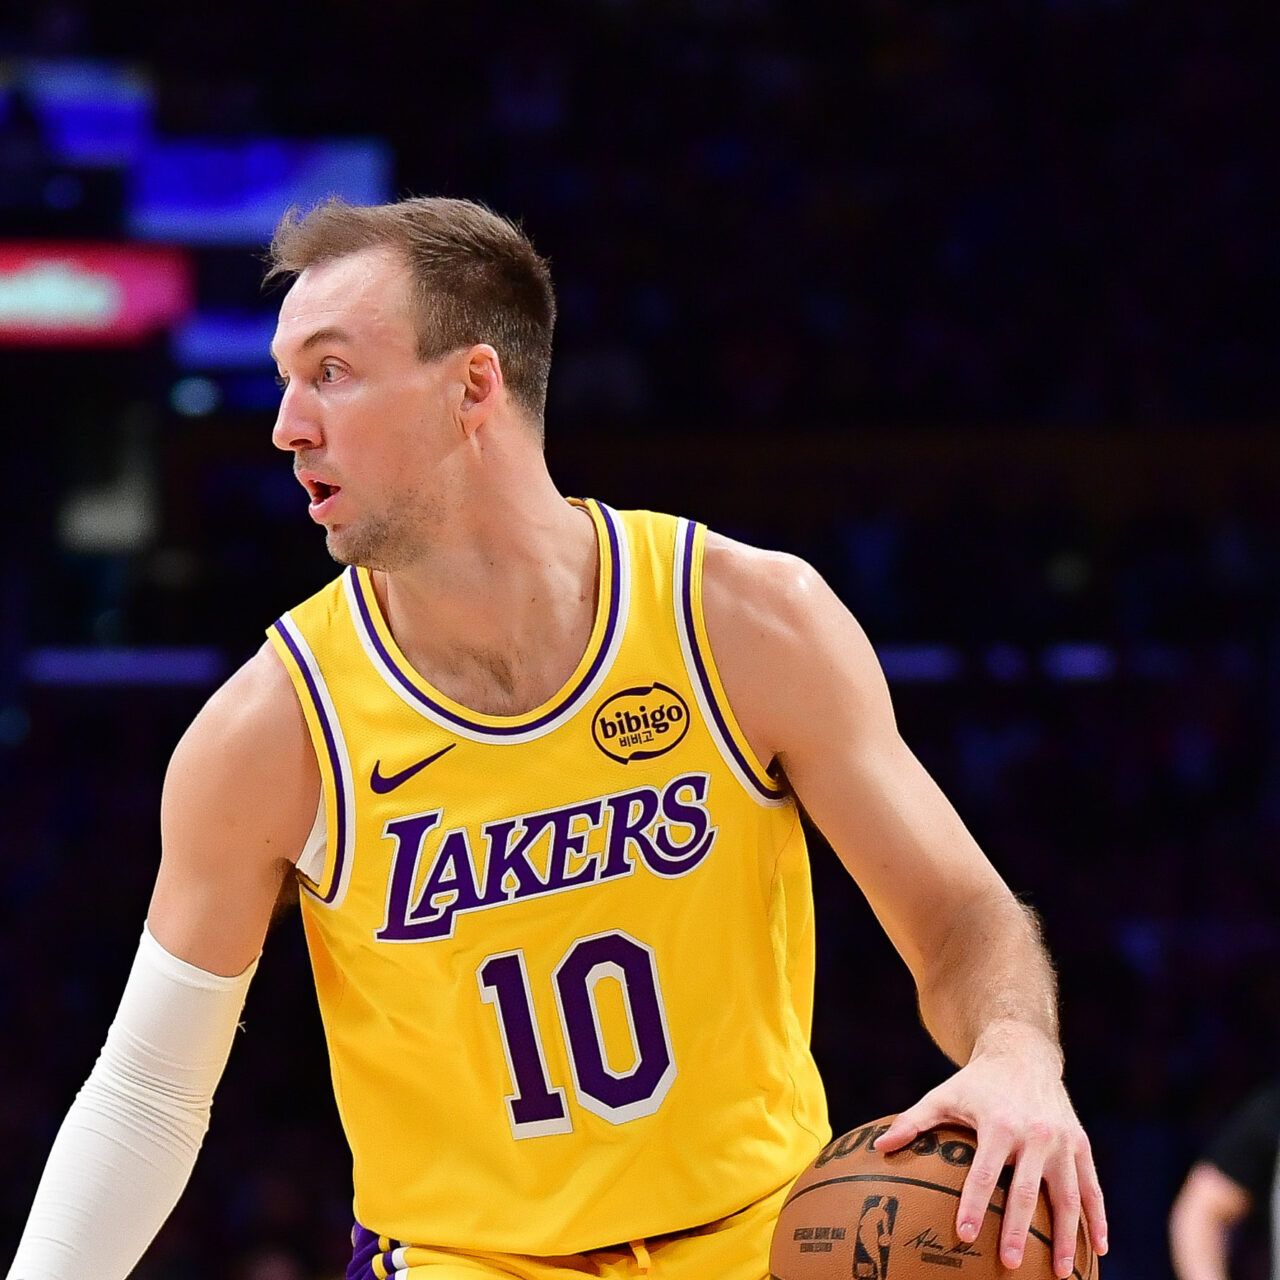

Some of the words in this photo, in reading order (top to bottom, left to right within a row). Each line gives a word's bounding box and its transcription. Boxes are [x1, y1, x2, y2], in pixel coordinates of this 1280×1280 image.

[599, 704, 684, 739] bibigo
[618, 730, 655, 748] 비비고
[374, 771, 719, 943] LAKERS
[475, 928, 678, 1141] 10
